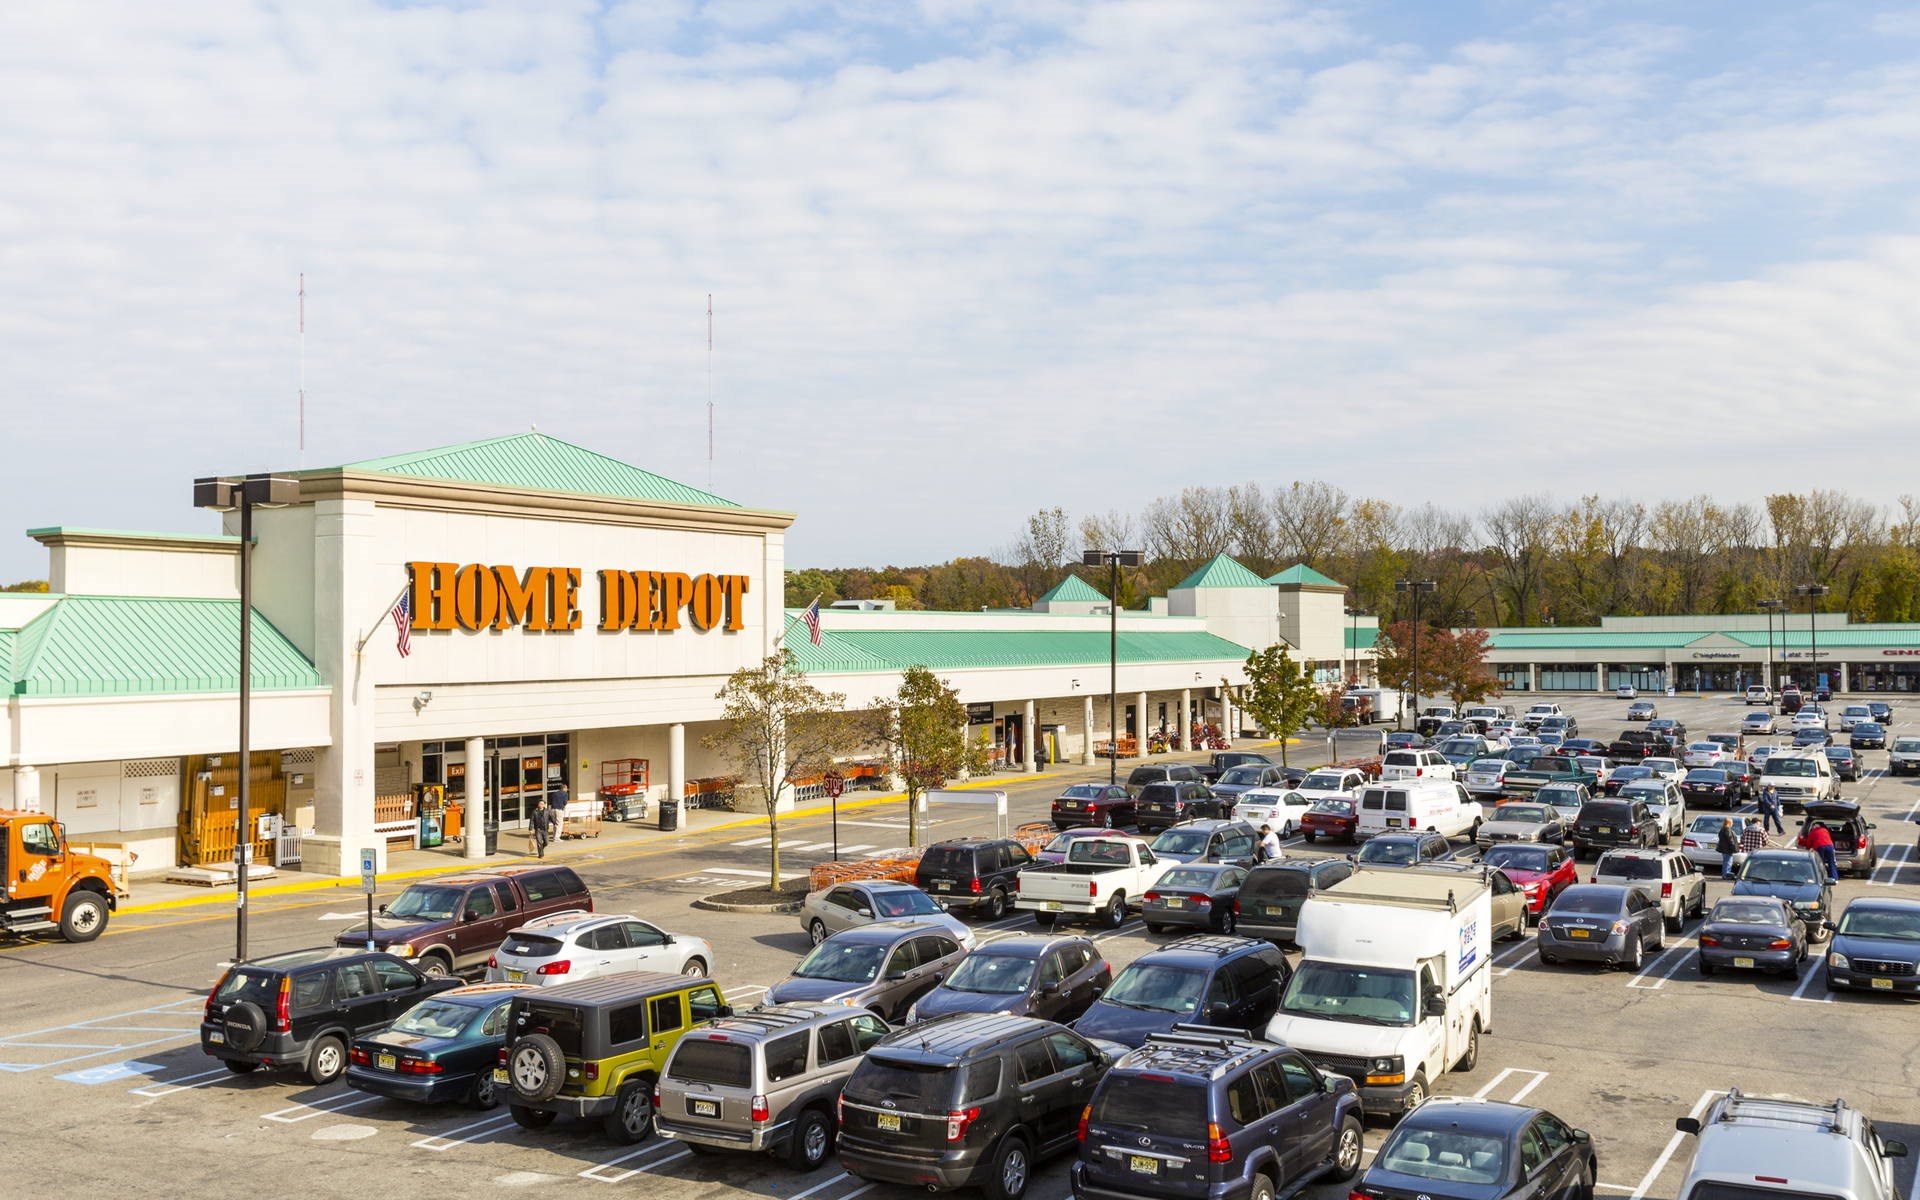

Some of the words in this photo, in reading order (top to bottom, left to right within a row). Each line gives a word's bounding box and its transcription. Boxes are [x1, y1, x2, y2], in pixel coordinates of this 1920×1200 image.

[405, 561, 582, 631] HOME
[597, 569, 750, 632] DEPOT
[526, 760, 537, 769] Exit
[451, 766, 465, 776] Exit
[825, 777, 843, 789] STOP
[227, 1021, 252, 1031] HONDA
